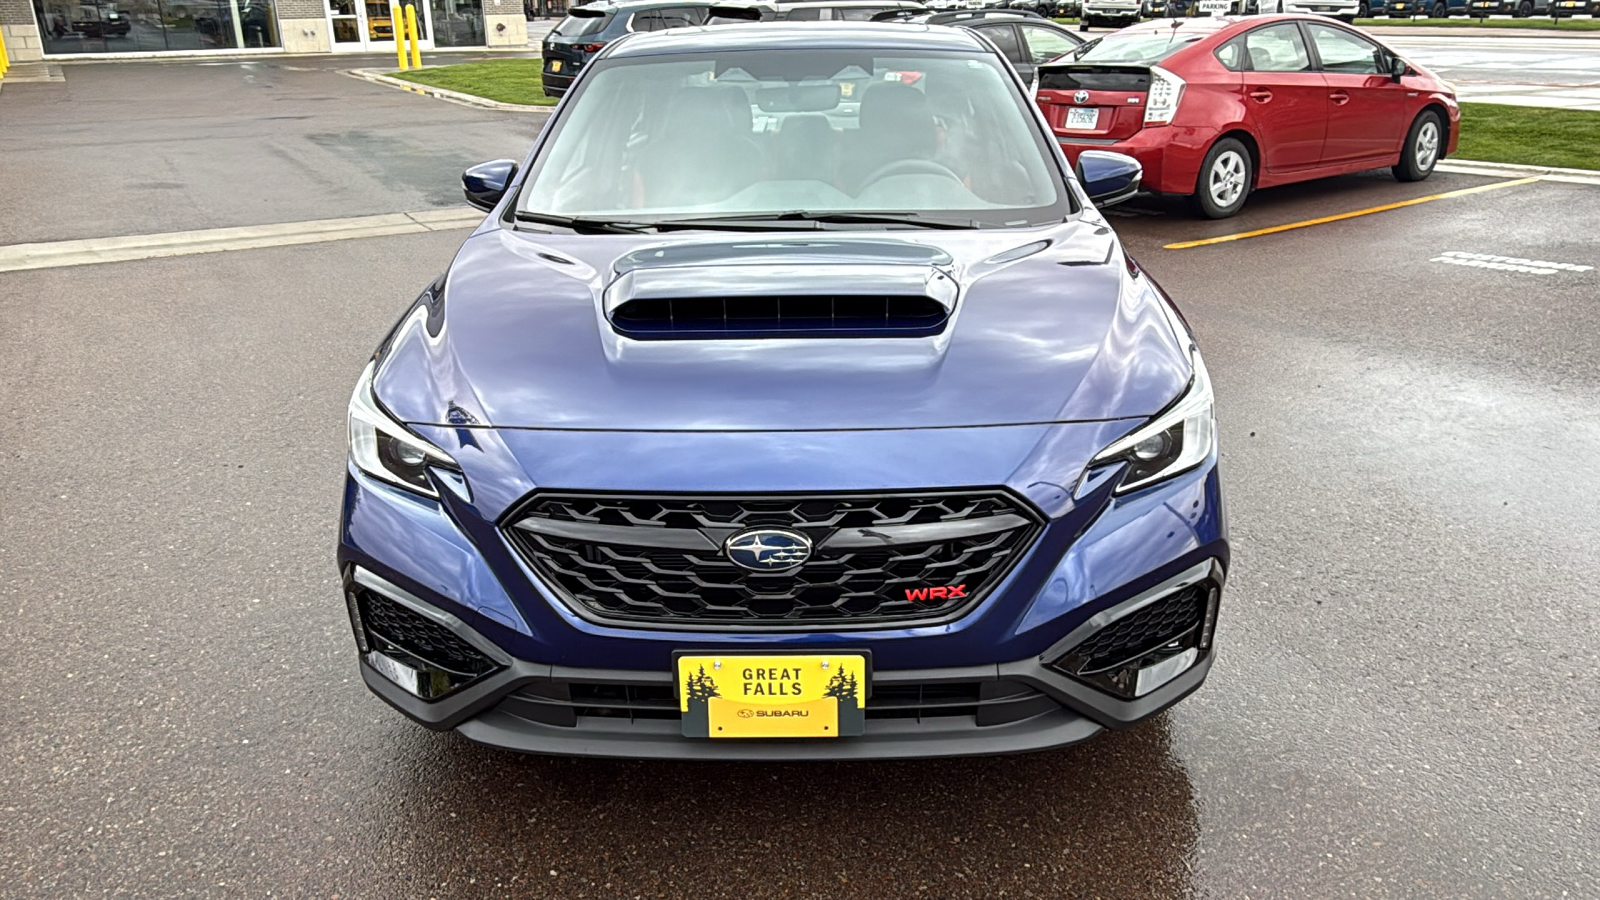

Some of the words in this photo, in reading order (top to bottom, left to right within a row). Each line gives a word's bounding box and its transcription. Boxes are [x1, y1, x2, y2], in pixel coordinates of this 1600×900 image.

[905, 584, 966, 602] WRX
[742, 668, 802, 680] GREAT
[743, 682, 803, 696] FALLS
[756, 710, 809, 718] SUBARU
